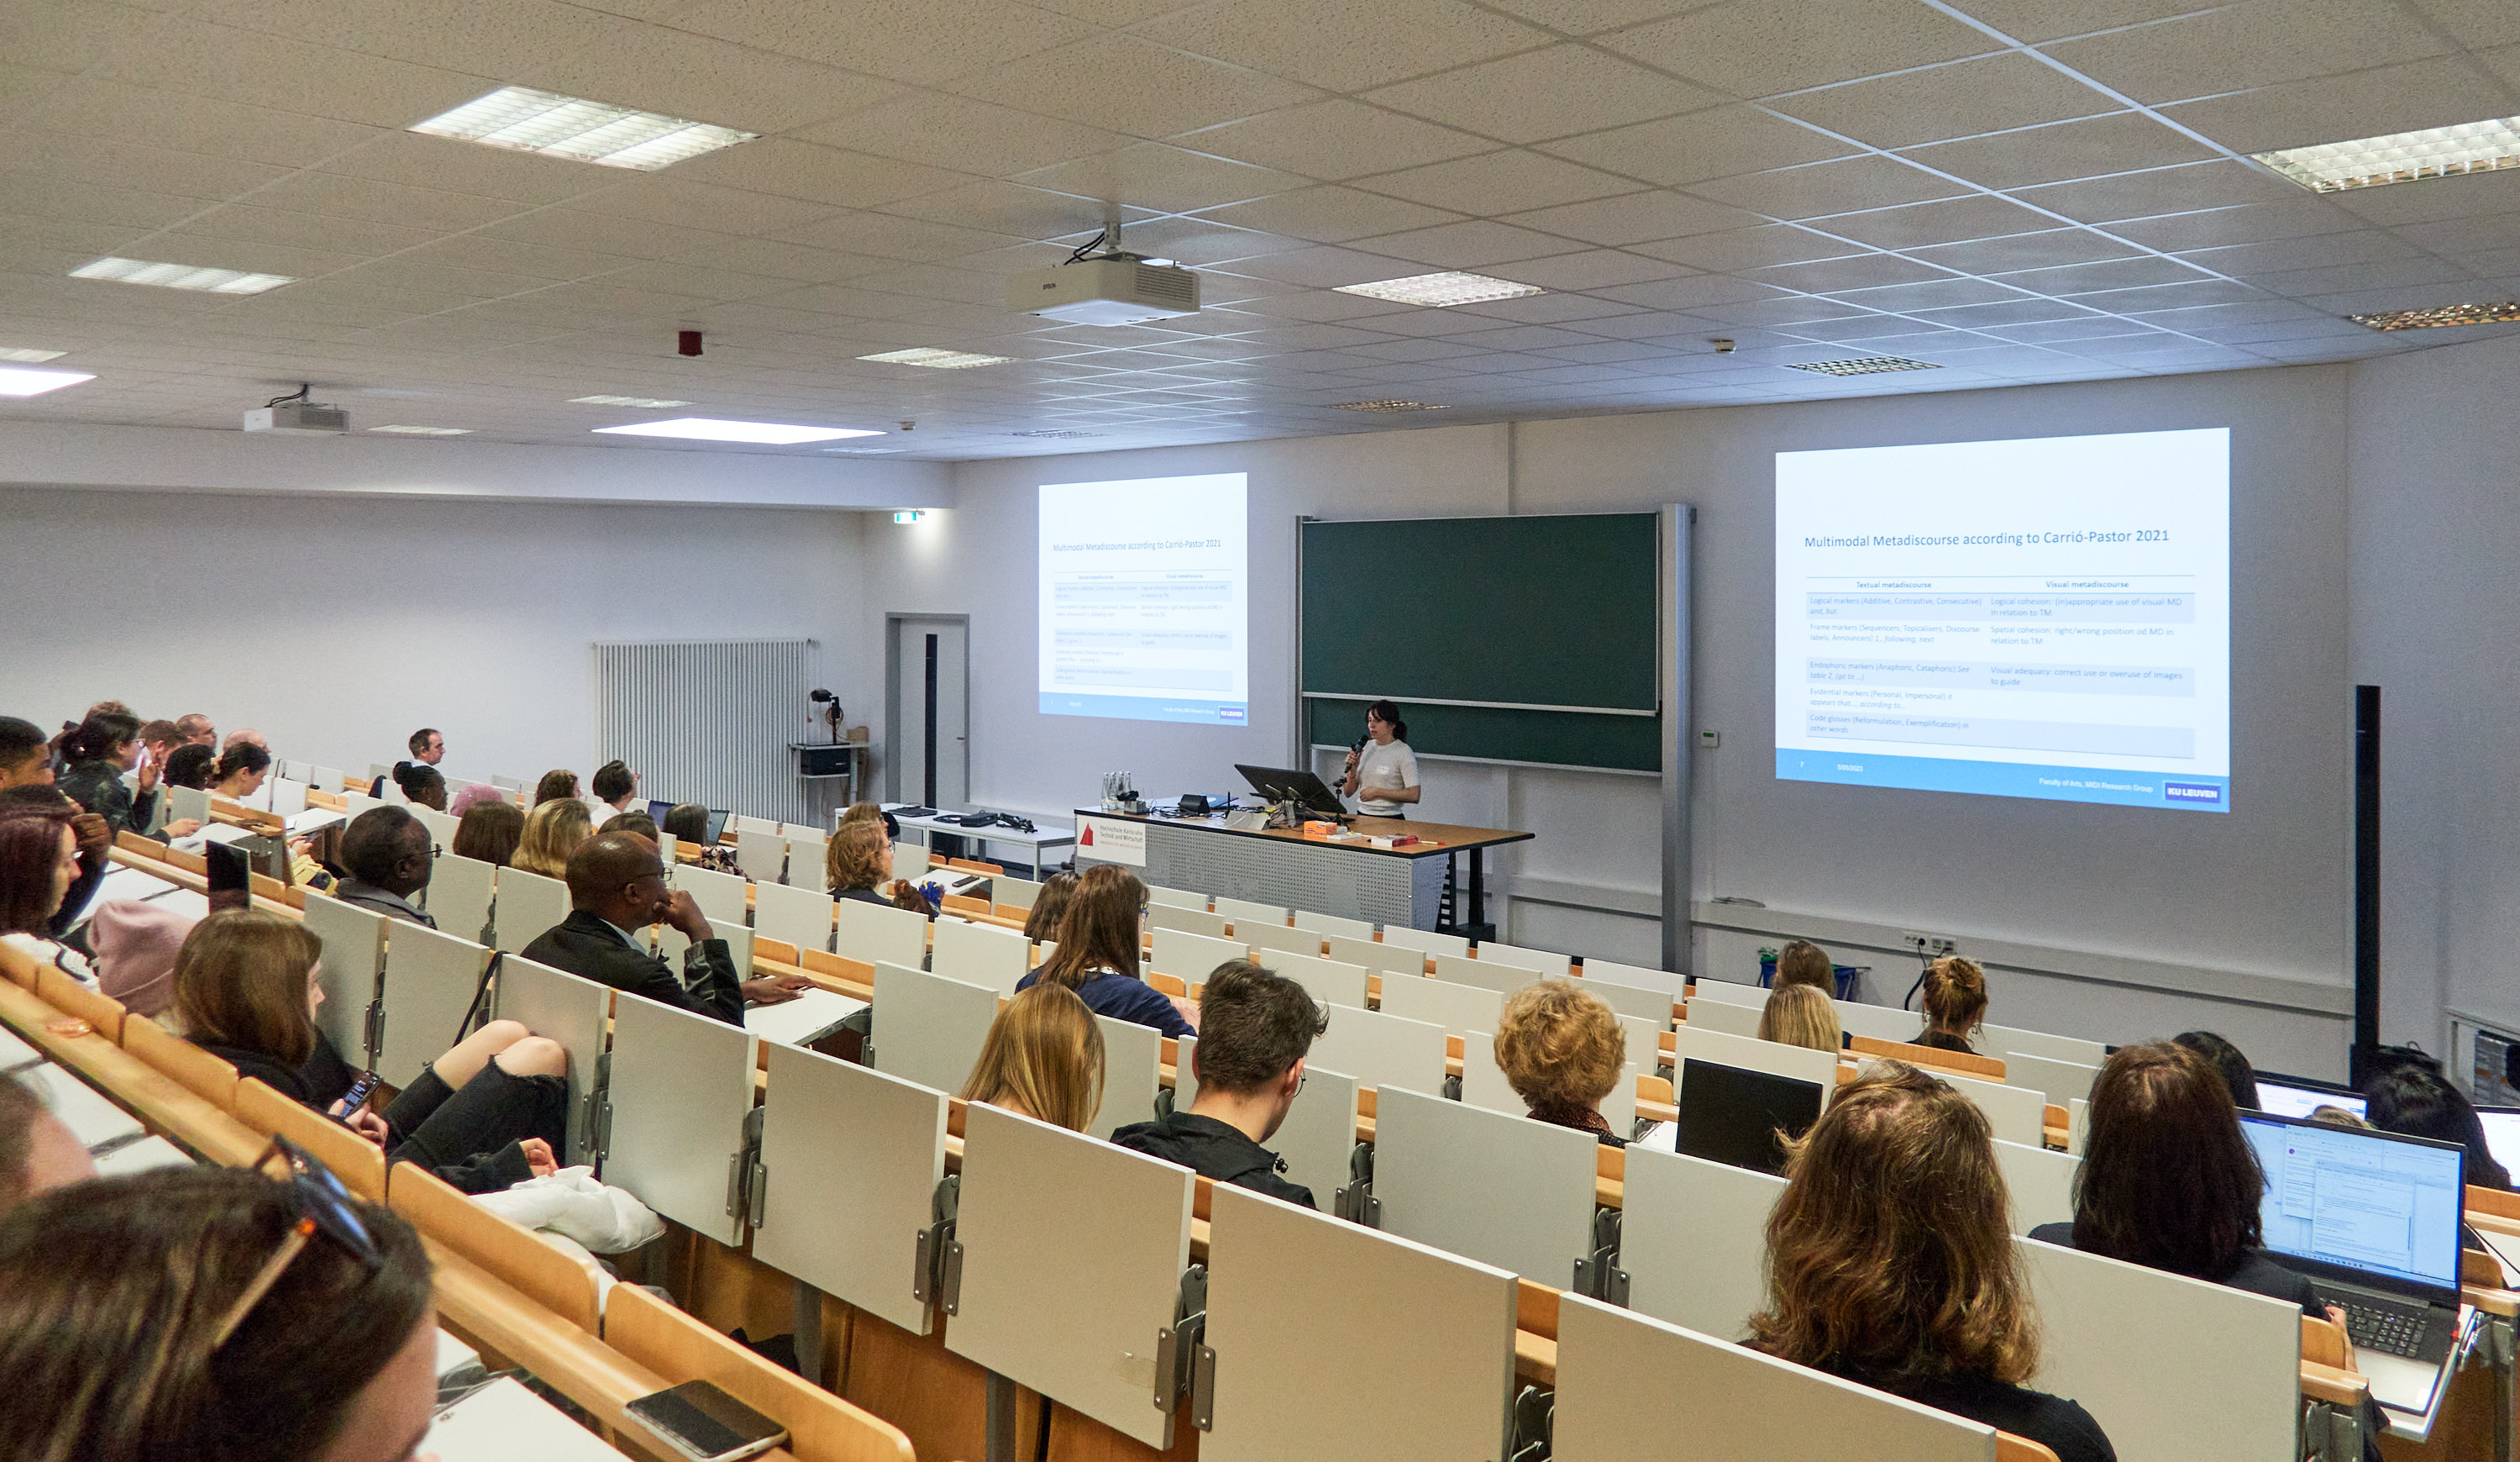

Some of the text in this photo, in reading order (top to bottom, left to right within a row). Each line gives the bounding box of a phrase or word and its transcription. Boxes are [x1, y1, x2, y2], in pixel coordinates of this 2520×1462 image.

[1804, 529, 2170, 547] Multimodal Metadiscourse according to Carrió-Pastor 2021
[1085, 542, 1126, 550] Metadiscourse
[1128, 540, 1157, 550] according
[1165, 539, 1205, 549] Carrió-Pastor
[1205, 539, 1221, 547] 2021
[1810, 597, 1832, 606] Logical
[1861, 597, 1893, 606] (Additive,
[1894, 597, 1935, 606] Contrastive,
[1936, 597, 1982, 606] Consecutive)
[1990, 598, 2016, 607] Logical
[2055, 598, 2113, 607] (in)appropriate
[1990, 626, 2015, 635] Spatial
[2054, 627, 2101, 636] right/wrong
[2103, 628, 2134, 636] position
[1809, 661, 1847, 670] Endophoric
[1848, 662, 1874, 671] markers
[2153, 671, 2182, 681] images
[2000, 678, 2021, 686] guide
[1842, 689, 1869, 697] markers
[1905, 692, 1945, 701] Impersonal)
[1859, 701, 1892, 710] according
[1852, 716, 1904, 726] (Reformulation,
[1906, 719, 1961, 729] Exemplification)
[2039, 778, 2061, 787] Faculty
[2102, 782, 2132, 791] Research
[2134, 784, 2154, 793] Group
[2166, 787, 2218, 798] KU LEUVEN
